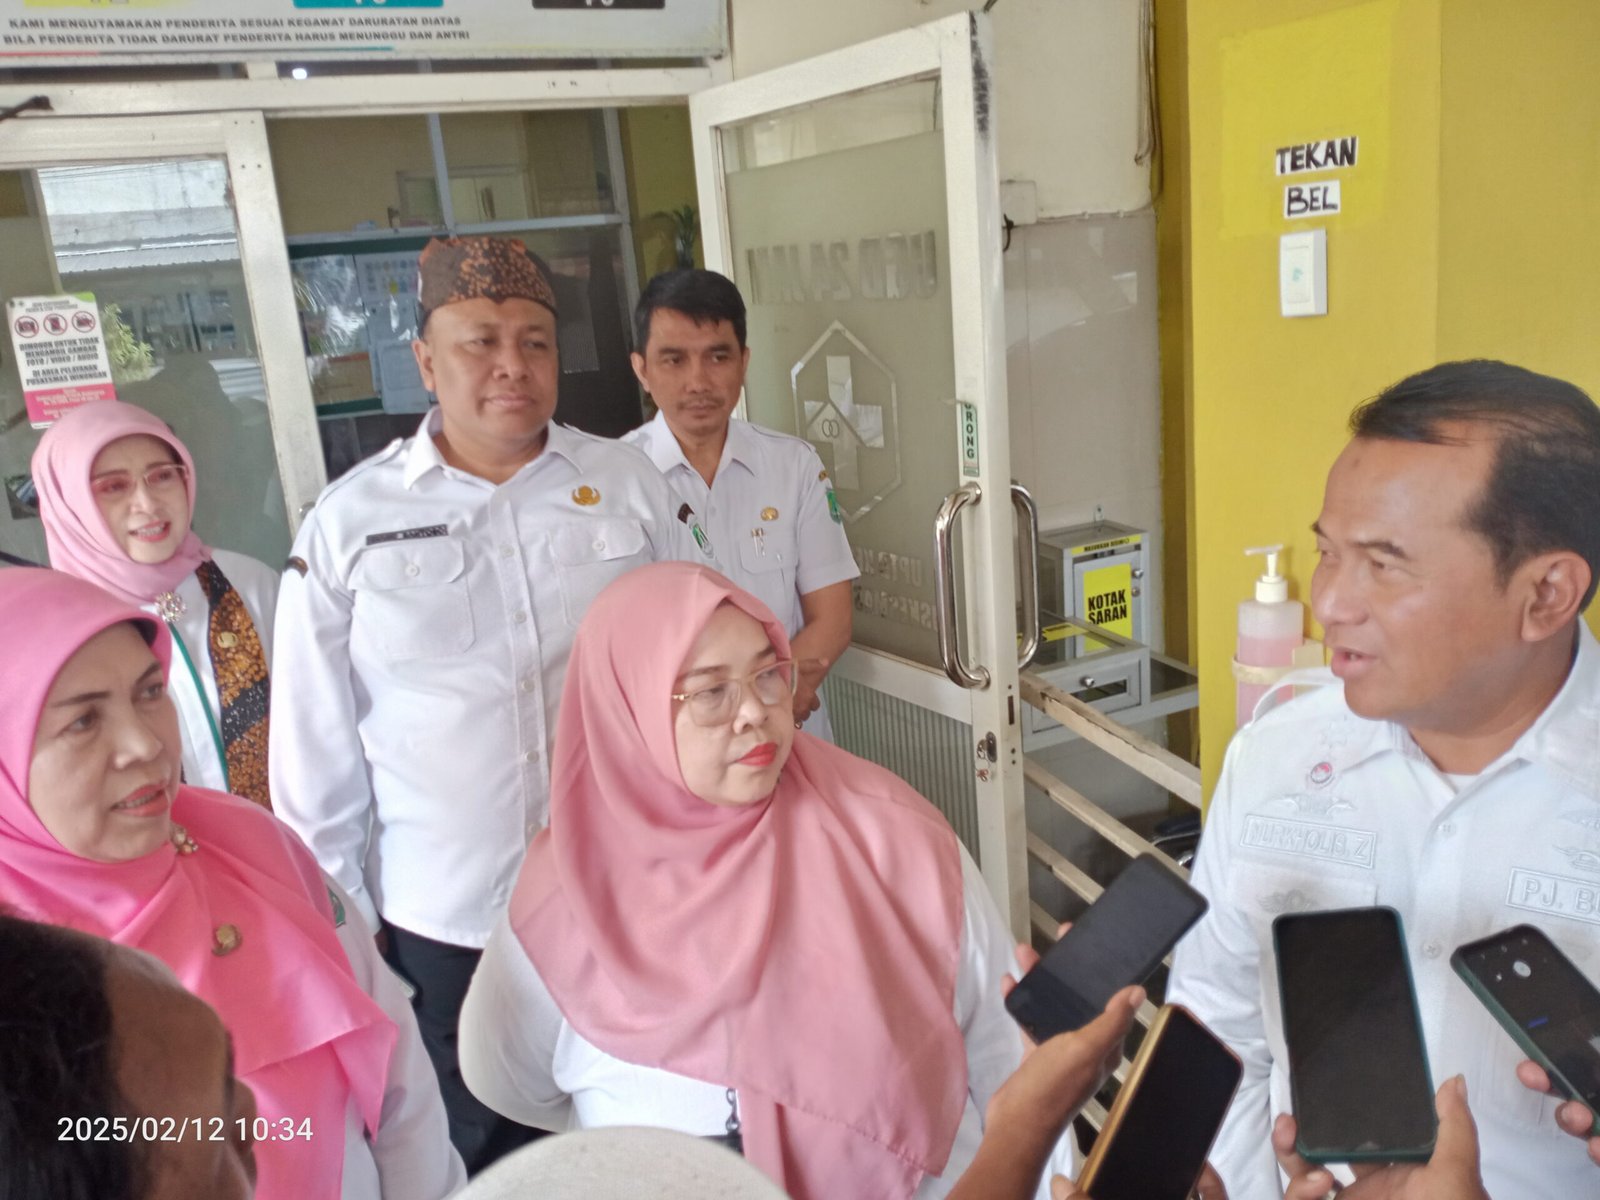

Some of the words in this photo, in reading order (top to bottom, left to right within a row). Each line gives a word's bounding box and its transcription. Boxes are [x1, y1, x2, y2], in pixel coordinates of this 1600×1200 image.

[9, 18, 44, 29] KAMI
[49, 18, 161, 29] MENGUTAMAKAN
[166, 18, 236, 29] PENDERITA
[240, 18, 284, 28] SESUAI
[287, 17, 345, 27] KEGAWAT
[349, 17, 418, 27] DARURATAN
[421, 16, 461, 26] DIATAS
[3, 34, 35, 45] BILA
[39, 34, 115, 45] PENDERITA
[119, 34, 157, 44] TIDAK
[161, 33, 219, 44] DARURAT
[224, 32, 291, 43] PENDERITA
[295, 32, 336, 42] HARUS
[338, 31, 405, 41] MENUNGGU
[410, 31, 433, 40] DAN
[436, 31, 470, 40] ANTRI
[1275, 136, 1357, 174] TEKAN
[1286, 186, 1339, 217] BEL
[1088, 589, 1126, 612] KOTAK
[1088, 604, 1127, 626] SARAN
